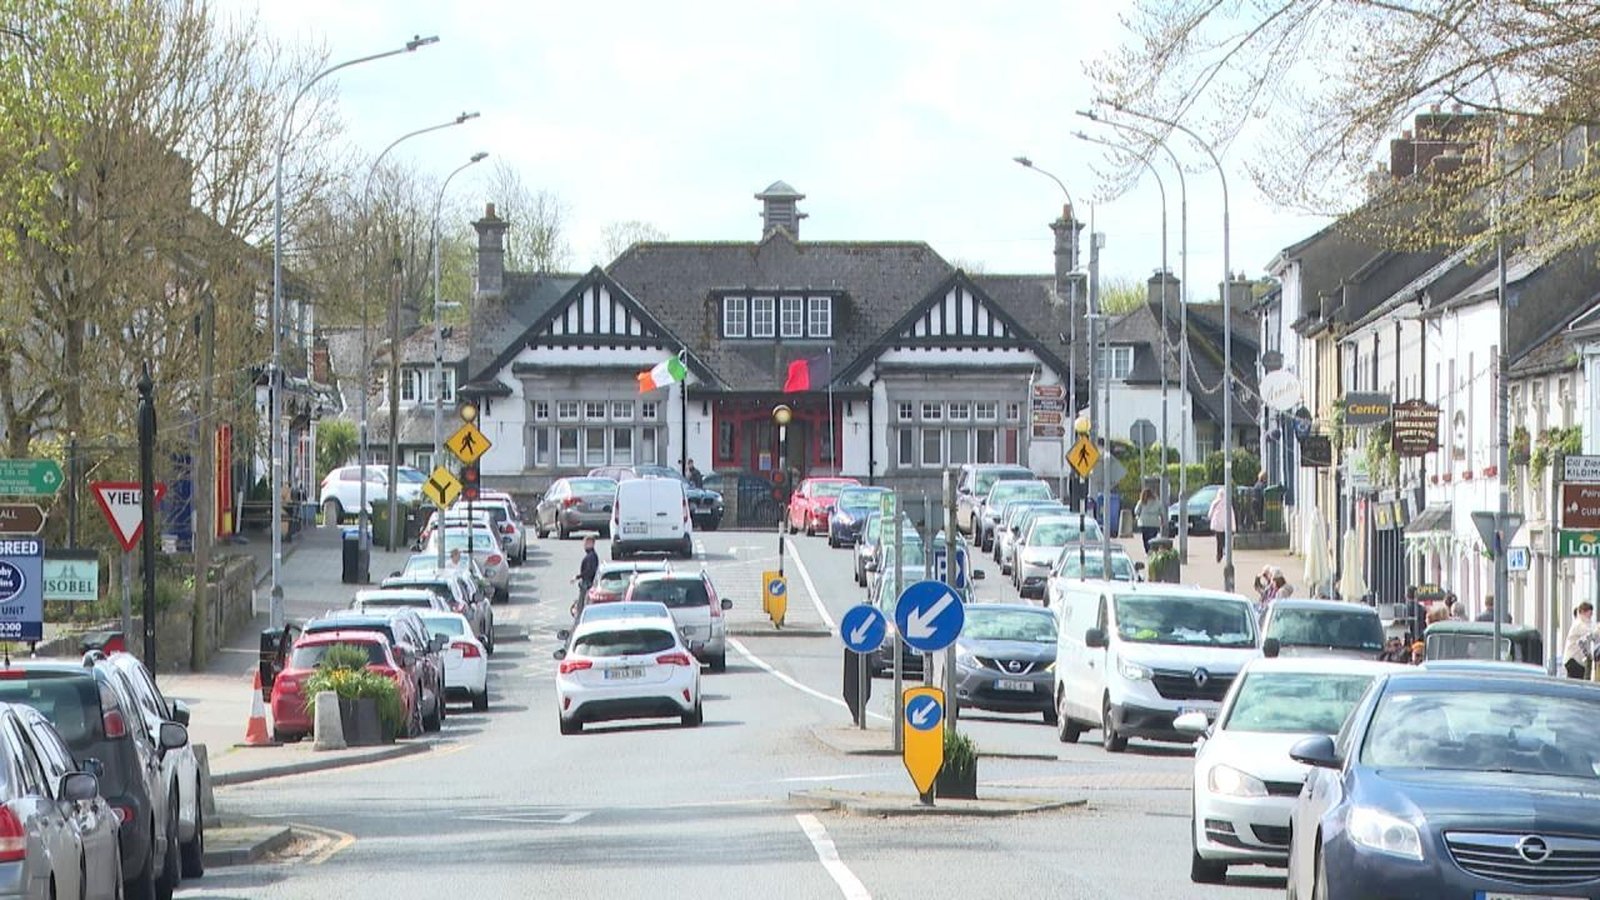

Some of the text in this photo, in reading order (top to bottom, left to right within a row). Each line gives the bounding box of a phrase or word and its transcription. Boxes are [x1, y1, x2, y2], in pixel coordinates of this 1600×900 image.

[1348, 403, 1389, 415] Centra
[107, 491, 142, 505] YIEL
[43, 580, 95, 593] ISOBEL
[2, 606, 25, 616] UNIT
